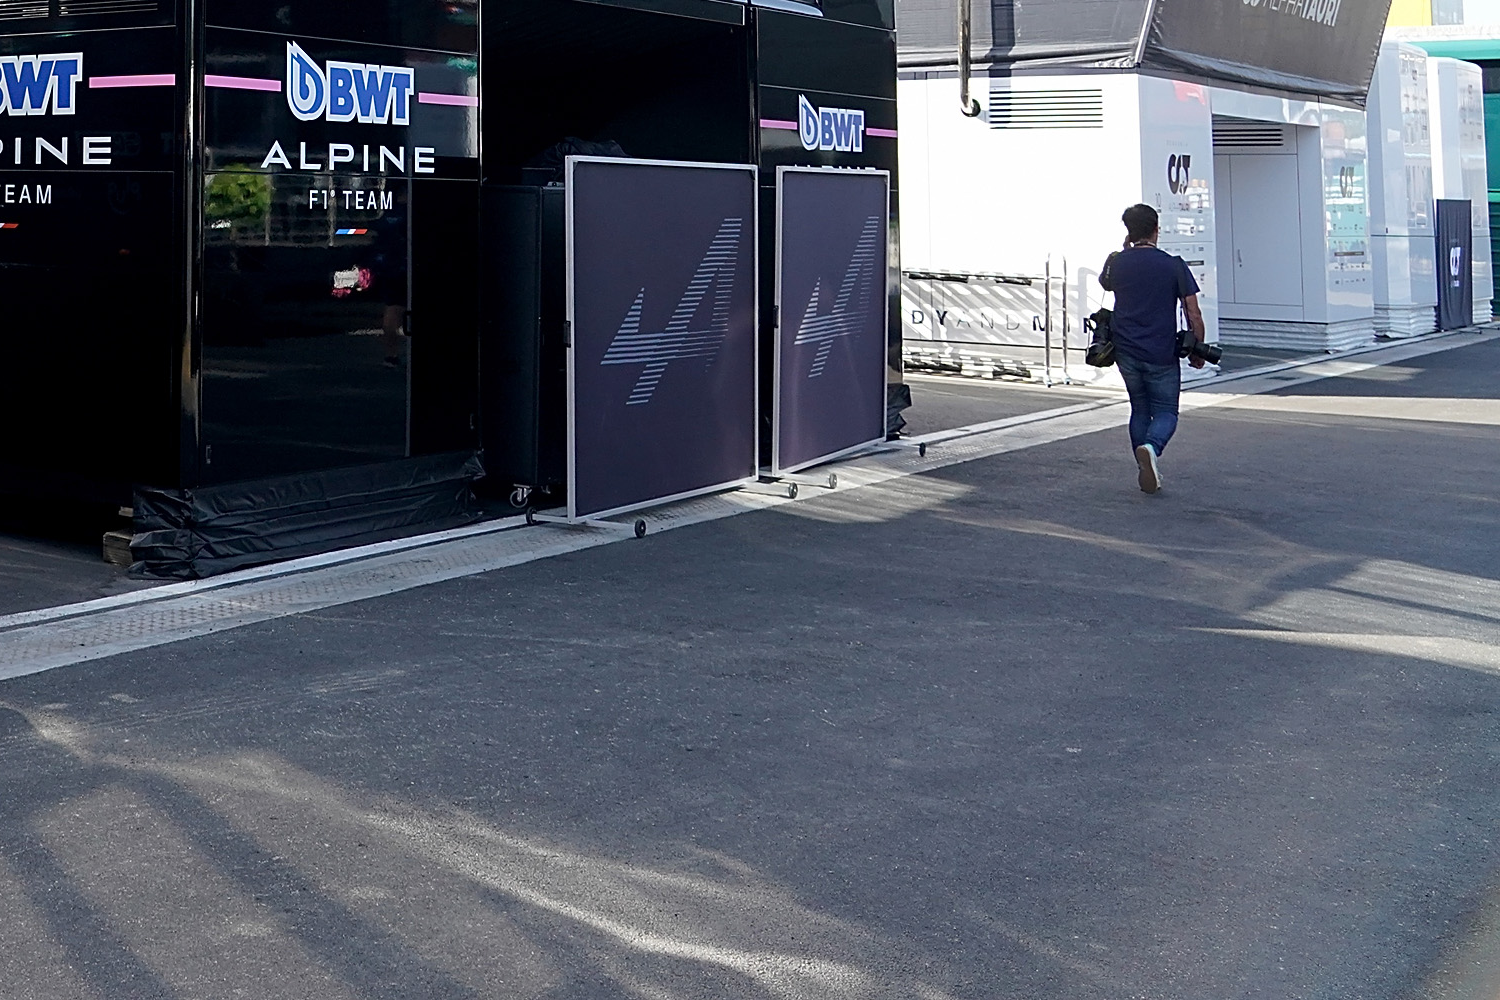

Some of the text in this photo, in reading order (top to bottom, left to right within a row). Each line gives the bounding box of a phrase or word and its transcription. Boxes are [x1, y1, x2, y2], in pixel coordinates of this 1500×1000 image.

[325, 60, 414, 125] BWT
[818, 107, 864, 153] BWT
[260, 140, 435, 173] ALPINE
[342, 190, 393, 210] TEAM
